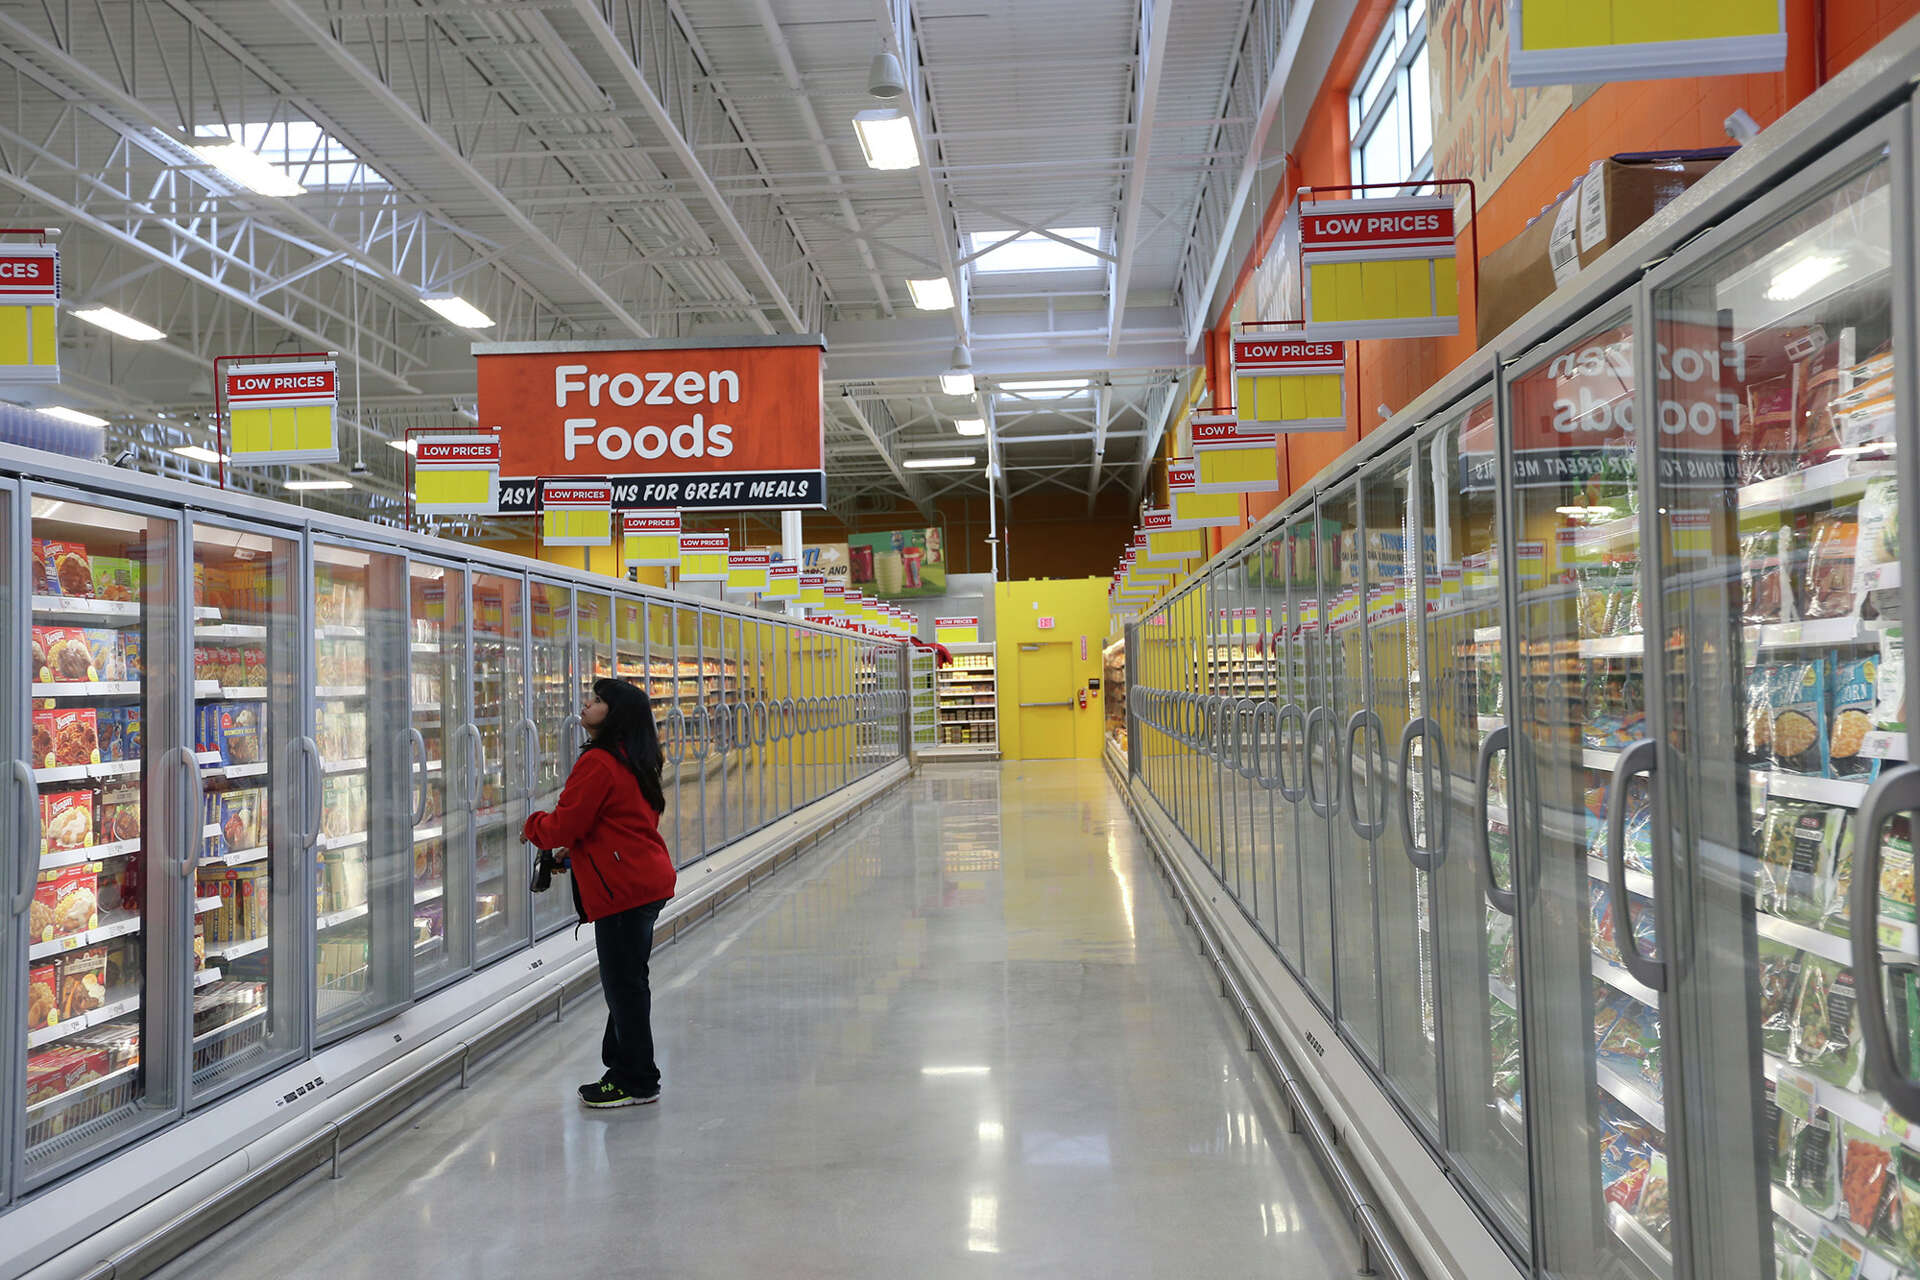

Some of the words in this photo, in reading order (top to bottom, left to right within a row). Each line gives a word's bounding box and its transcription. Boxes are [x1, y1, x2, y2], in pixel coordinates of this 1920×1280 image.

[1315, 218, 1362, 236] LOW
[1367, 215, 1440, 233] PRICES
[1244, 346, 1280, 358] LOW
[1282, 344, 1333, 356] PRICES
[236, 377, 271, 390] LOW
[274, 376, 325, 389] PRICES
[555, 364, 740, 408] Frozen
[1199, 426, 1225, 436] LOW
[564, 413, 734, 461] Foods
[423, 446, 447, 457] LOW
[452, 446, 492, 456] PRICES
[1175, 473, 1195, 481] LOW
[499, 487, 536, 505] ASY
[643, 483, 680, 501] FOR
[684, 481, 744, 500] GREAT
[749, 480, 809, 498] MEALS
[550, 491, 570, 499] LOW
[573, 490, 605, 499] PRICES
[628, 519, 648, 527] LOW
[649, 519, 676, 527] PRICES
[729, 556, 744, 564] LOW
[745, 555, 766, 563] PRICES
[828, 566, 848, 576] AND
